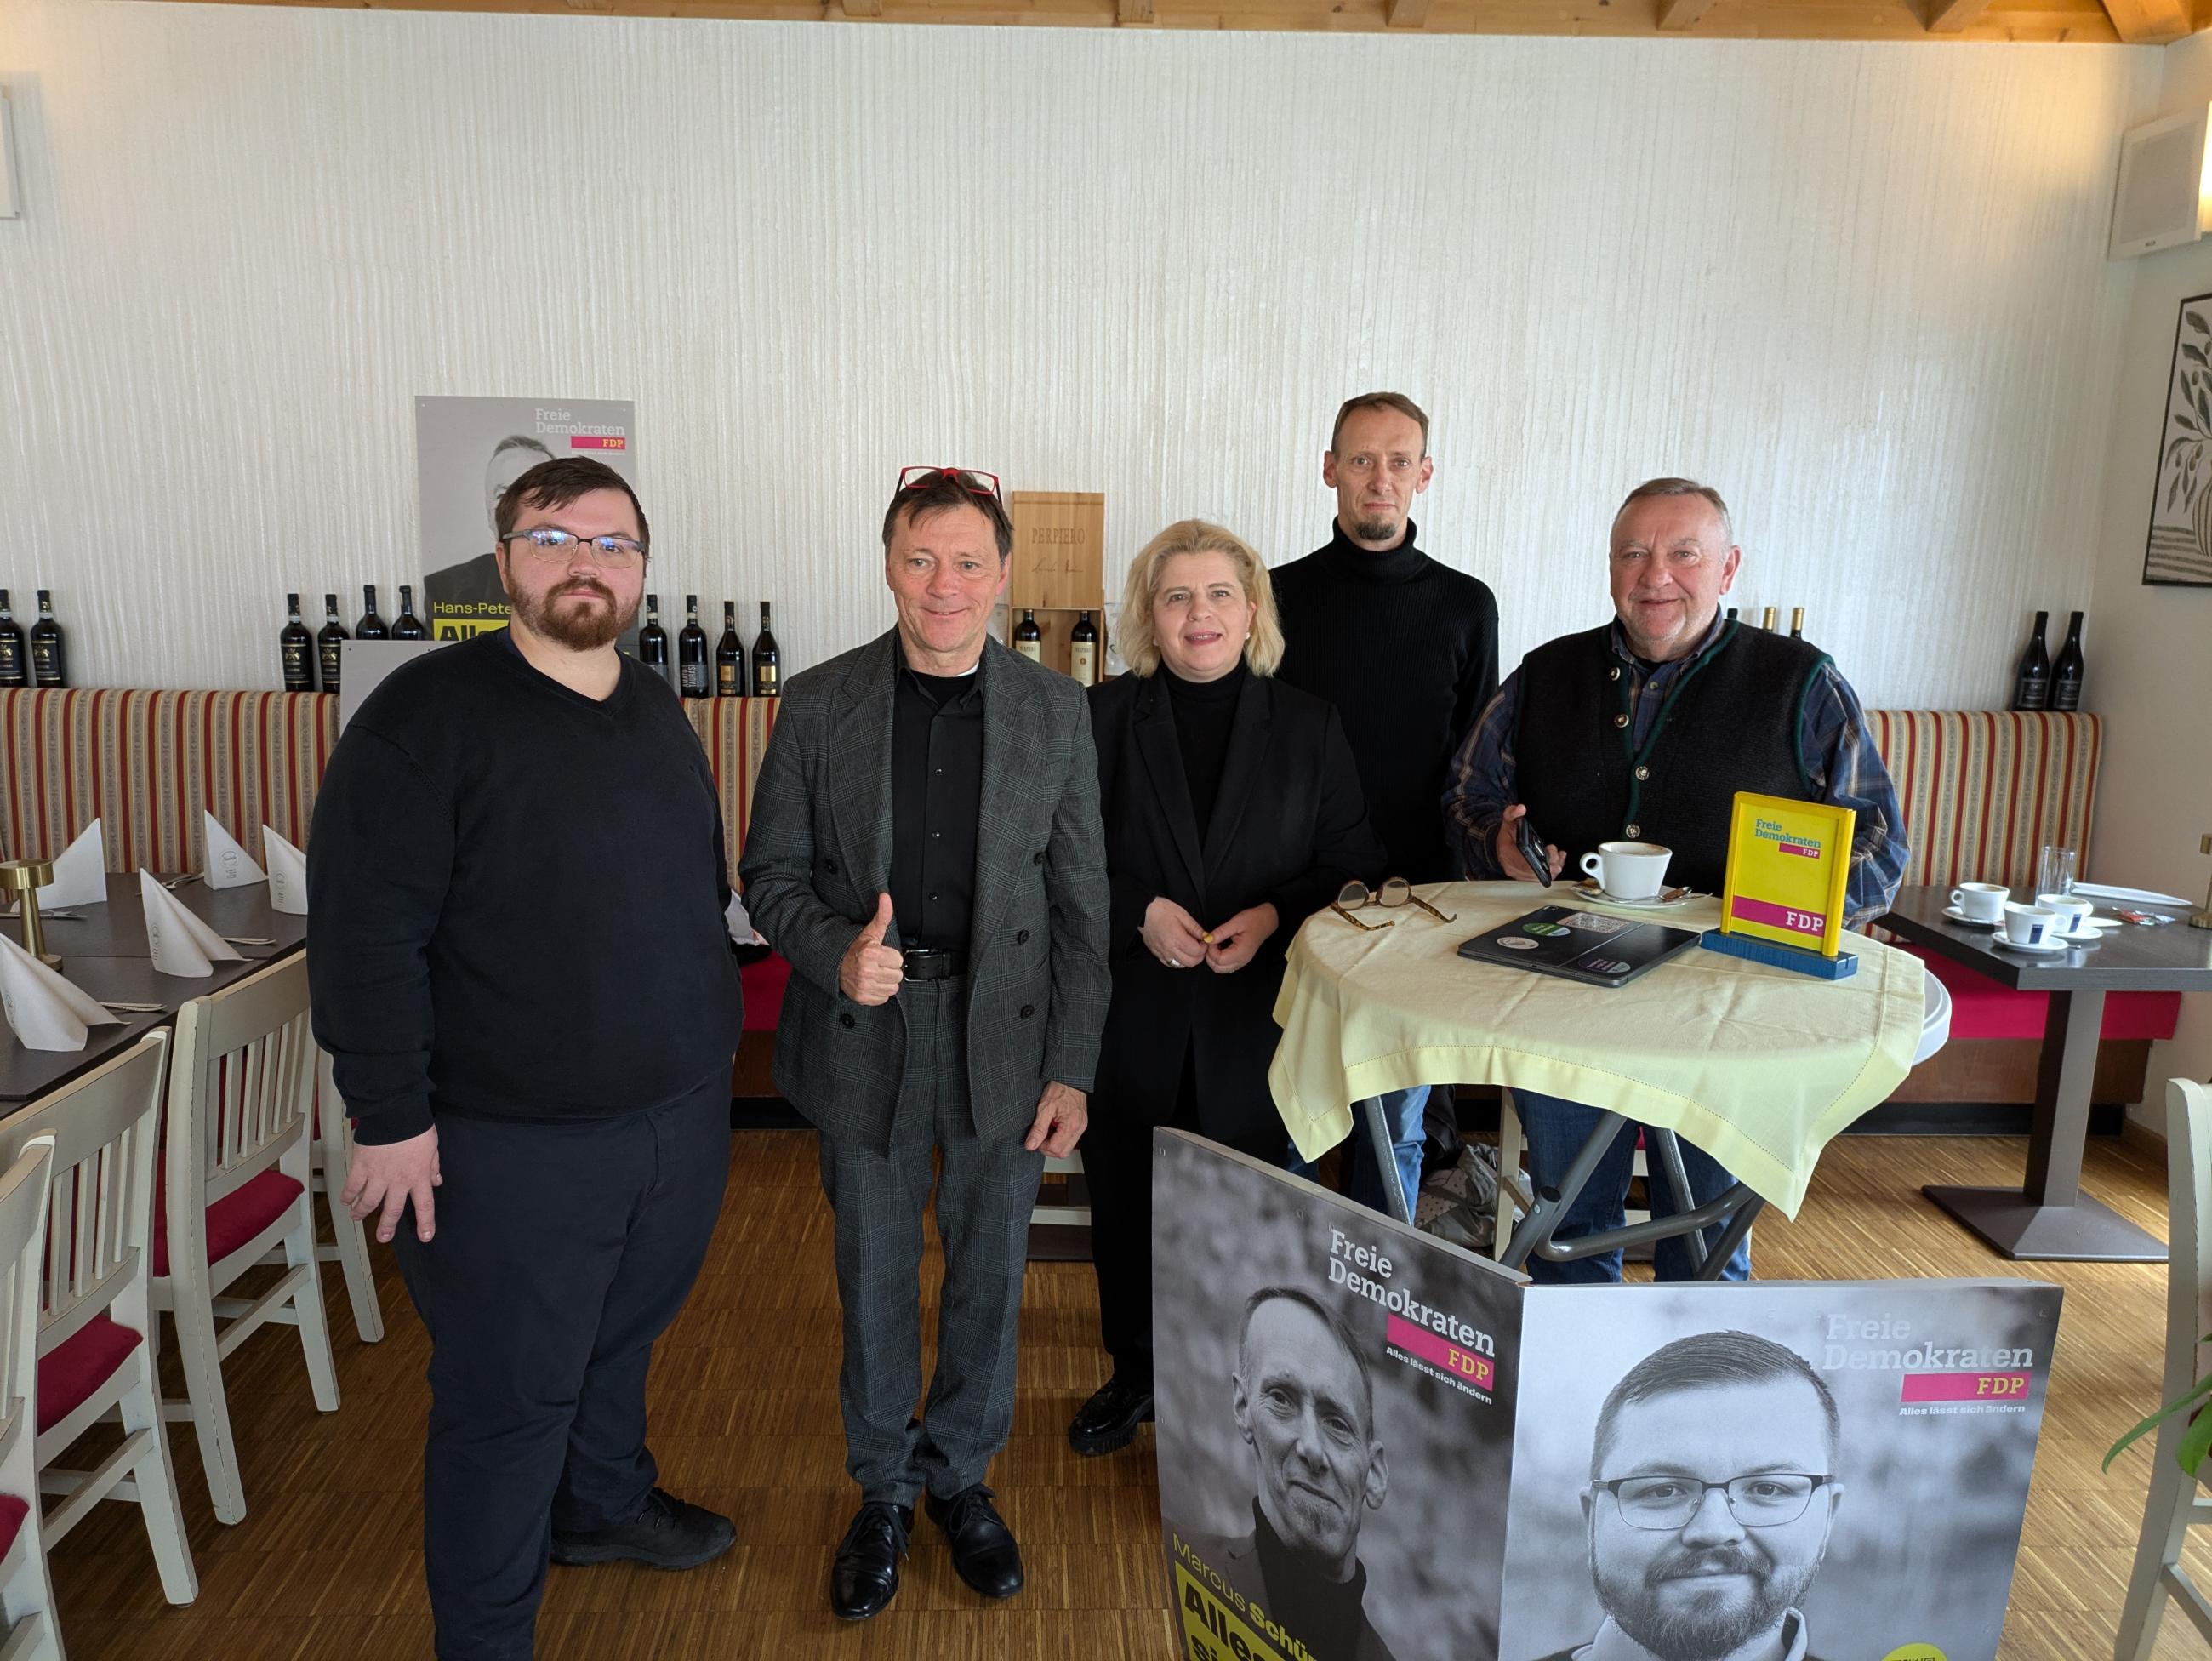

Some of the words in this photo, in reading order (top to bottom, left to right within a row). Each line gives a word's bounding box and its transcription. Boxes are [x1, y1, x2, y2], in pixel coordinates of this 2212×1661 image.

[535, 408, 571, 421] Freie
[536, 422, 625, 435] Demokraten
[602, 439, 624, 448] FDP
[1032, 528, 1085, 545] PERPIERO
[1756, 819, 1782, 831] Freie
[1755, 829, 1821, 848] Demokraten
[1803, 848, 1818, 858] FDP
[1786, 911, 1824, 932] FDP
[1330, 1229, 1393, 1278] Freie
[1328, 1256, 1495, 1358] Demokraten
[1827, 1313, 1911, 1340] Freie
[1448, 1349, 1489, 1380] FDP
[1822, 1341, 2033, 1371] Demokraten
[1386, 1346, 1409, 1364] Alles
[1410, 1357, 1434, 1377] lässt
[1435, 1371, 1456, 1387] sich
[1457, 1380, 1492, 1405] ändern
[1976, 1377, 2025, 1395] FDP
[1899, 1407, 1927, 1416] Alles
[1929, 1405, 1958, 1415] lässt
[1960, 1405, 1984, 1414] sich
[1986, 1403, 2025, 1414] ändern
[1173, 1533, 1246, 1612] Marcus
